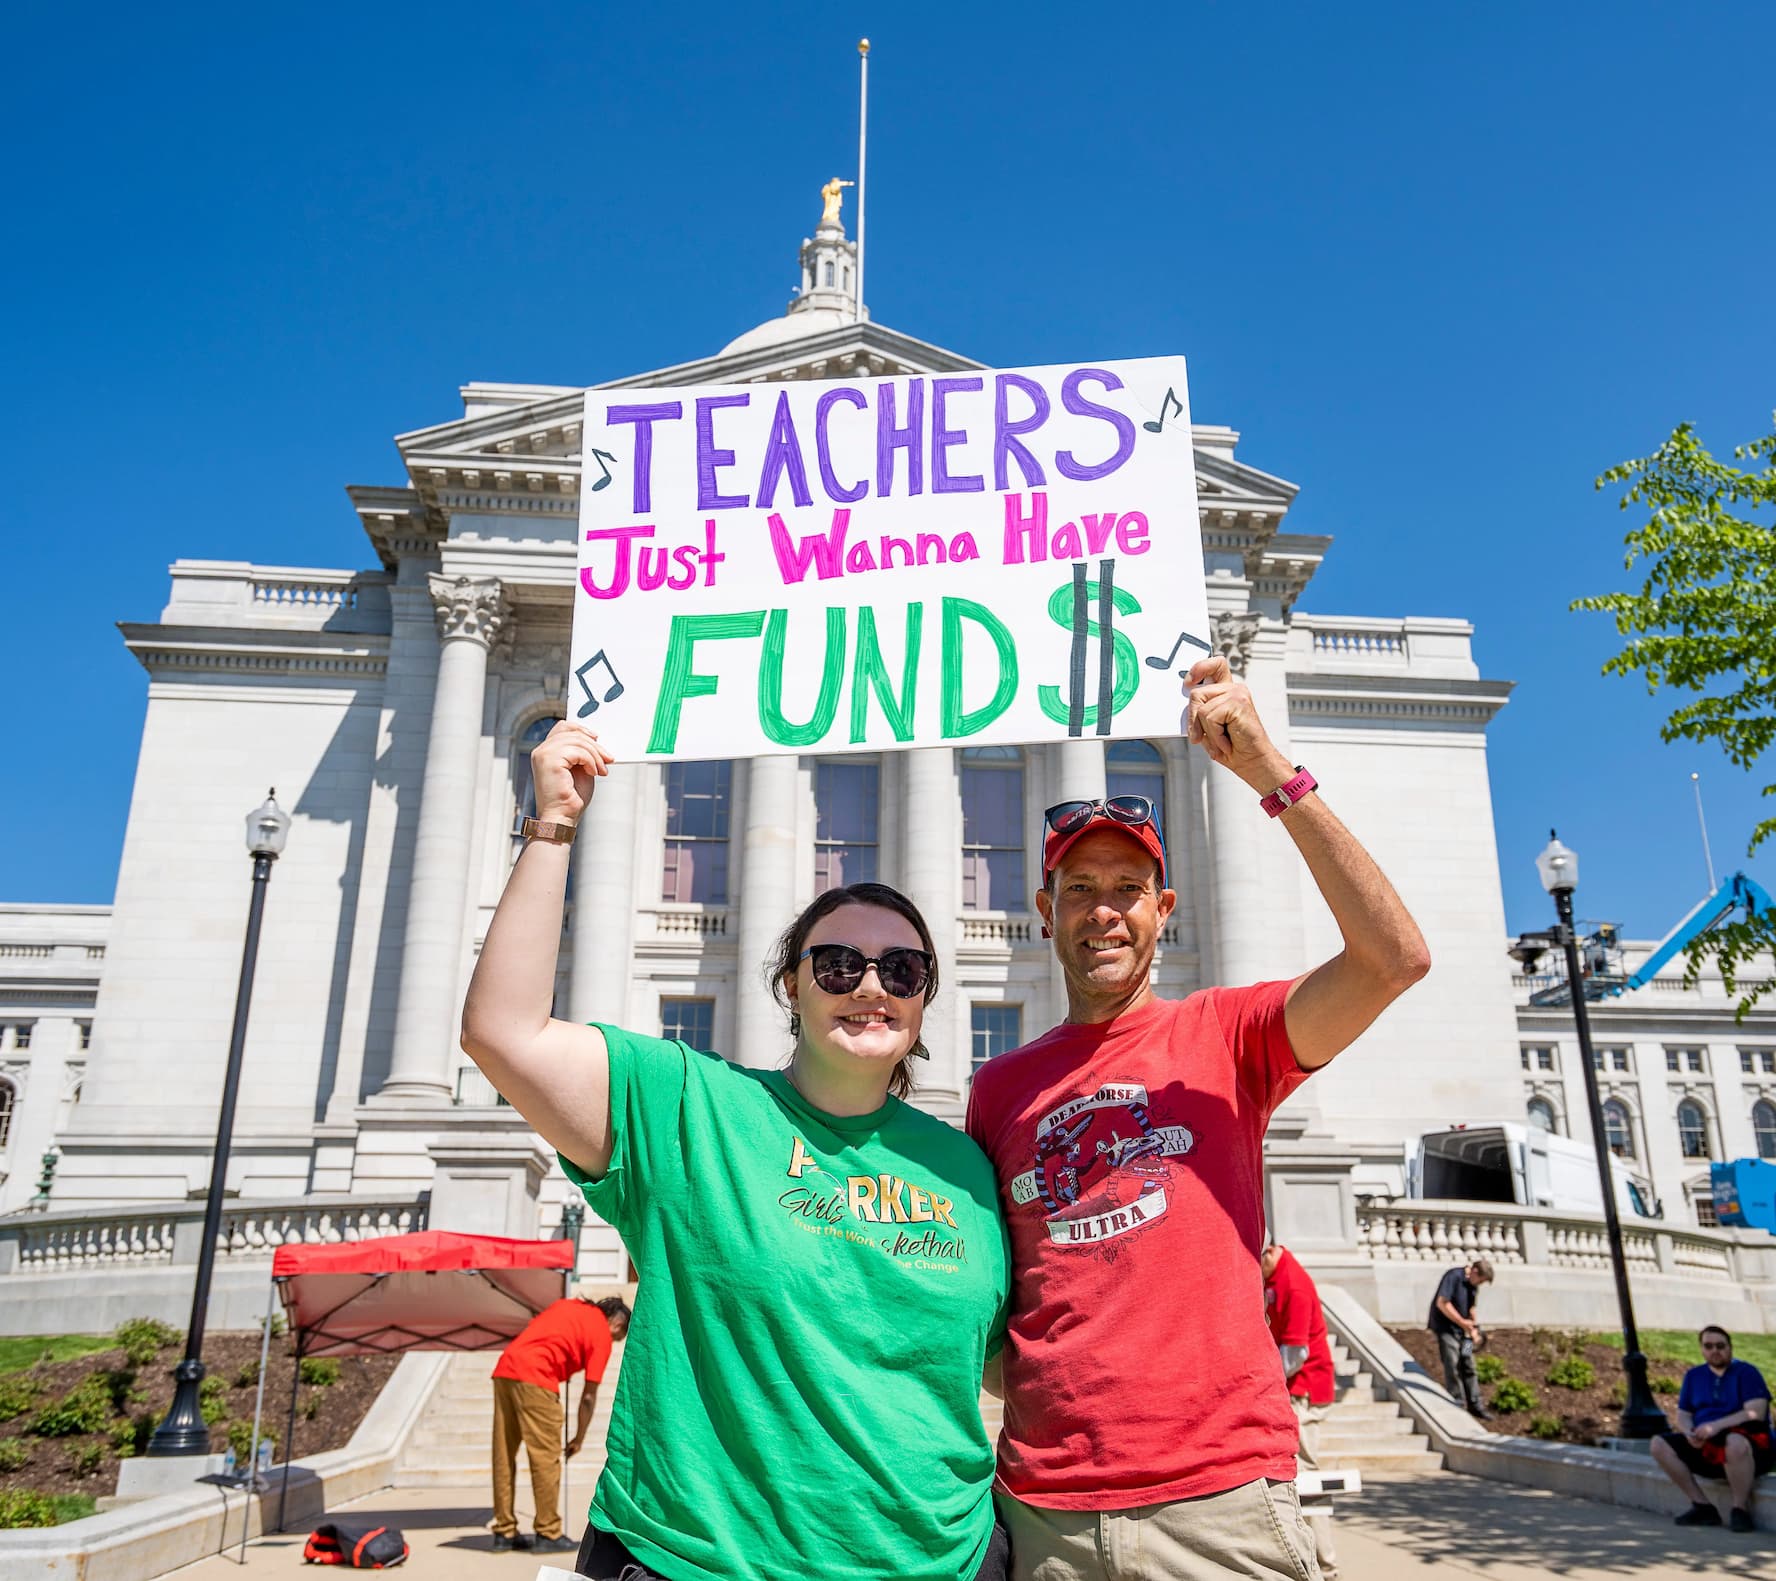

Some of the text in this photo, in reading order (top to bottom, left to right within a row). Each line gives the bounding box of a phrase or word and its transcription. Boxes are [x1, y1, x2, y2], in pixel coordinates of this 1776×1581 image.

[606, 368, 1137, 515] TEACHERS
[579, 491, 1151, 600] Just Wanna Have
[645, 558, 1143, 755] FUND$
[1164, 1129, 1185, 1141] UT
[1166, 1139, 1187, 1153] AH
[1014, 1176, 1032, 1192] MO
[778, 1187, 846, 1225] Girls
[823, 1225, 844, 1239] the
[1068, 1204, 1147, 1241] ULTRA
[914, 1259, 960, 1275] Change
